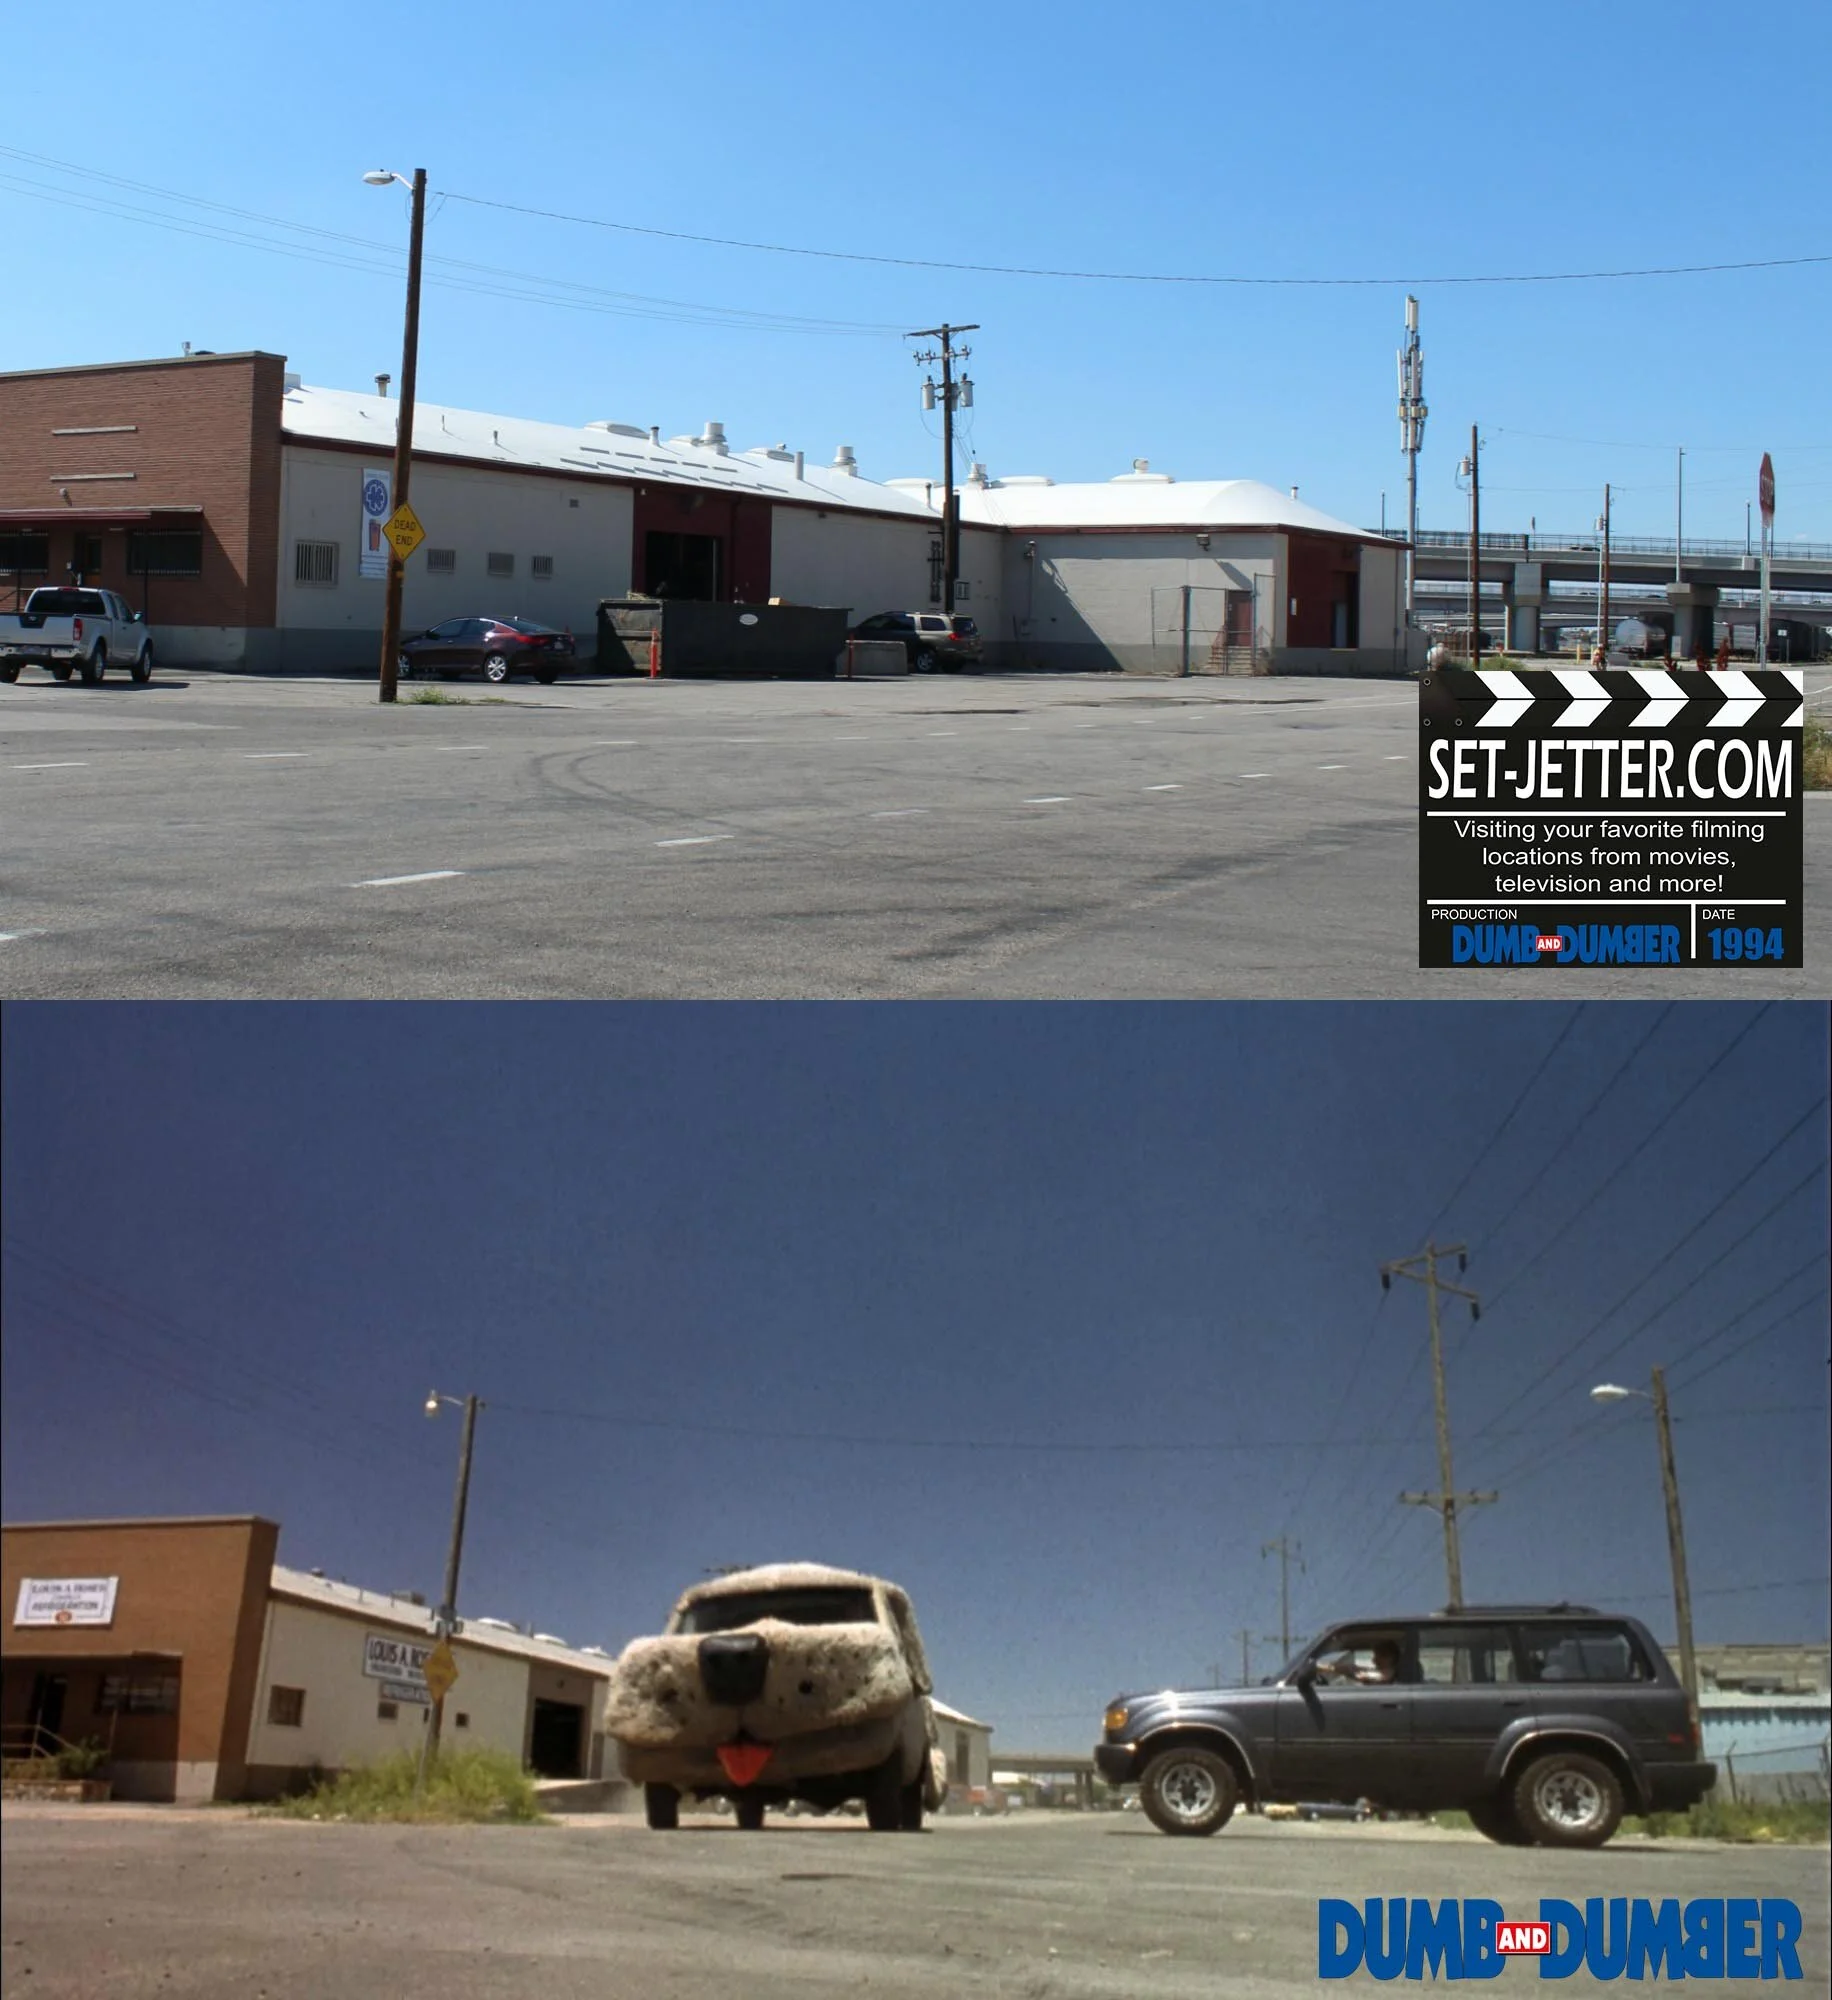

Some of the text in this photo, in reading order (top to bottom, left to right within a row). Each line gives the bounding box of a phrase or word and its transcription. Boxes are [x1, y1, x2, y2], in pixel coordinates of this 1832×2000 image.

[394, 519, 416, 531] DEAD
[395, 534, 413, 546] END
[368, 1639, 398, 1665] LOUIS
